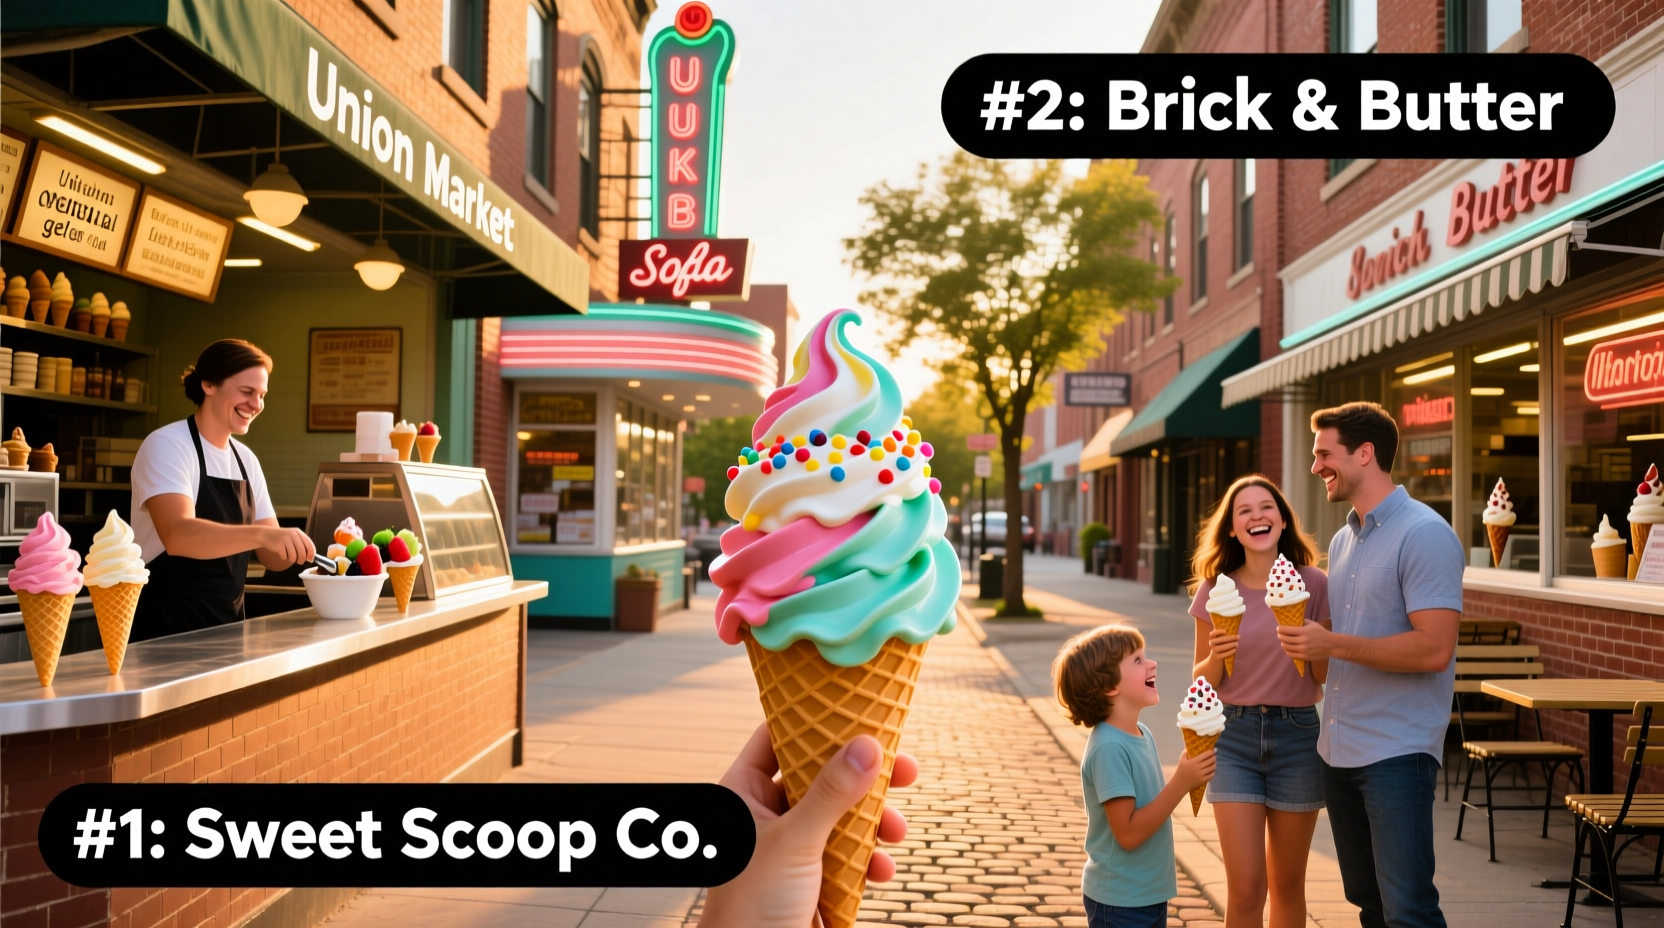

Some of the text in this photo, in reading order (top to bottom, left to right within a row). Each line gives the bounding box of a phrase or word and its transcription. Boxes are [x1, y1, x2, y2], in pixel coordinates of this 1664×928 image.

[307, 46, 515, 252] Union Market
[667, 56, 700, 229] UUKB
